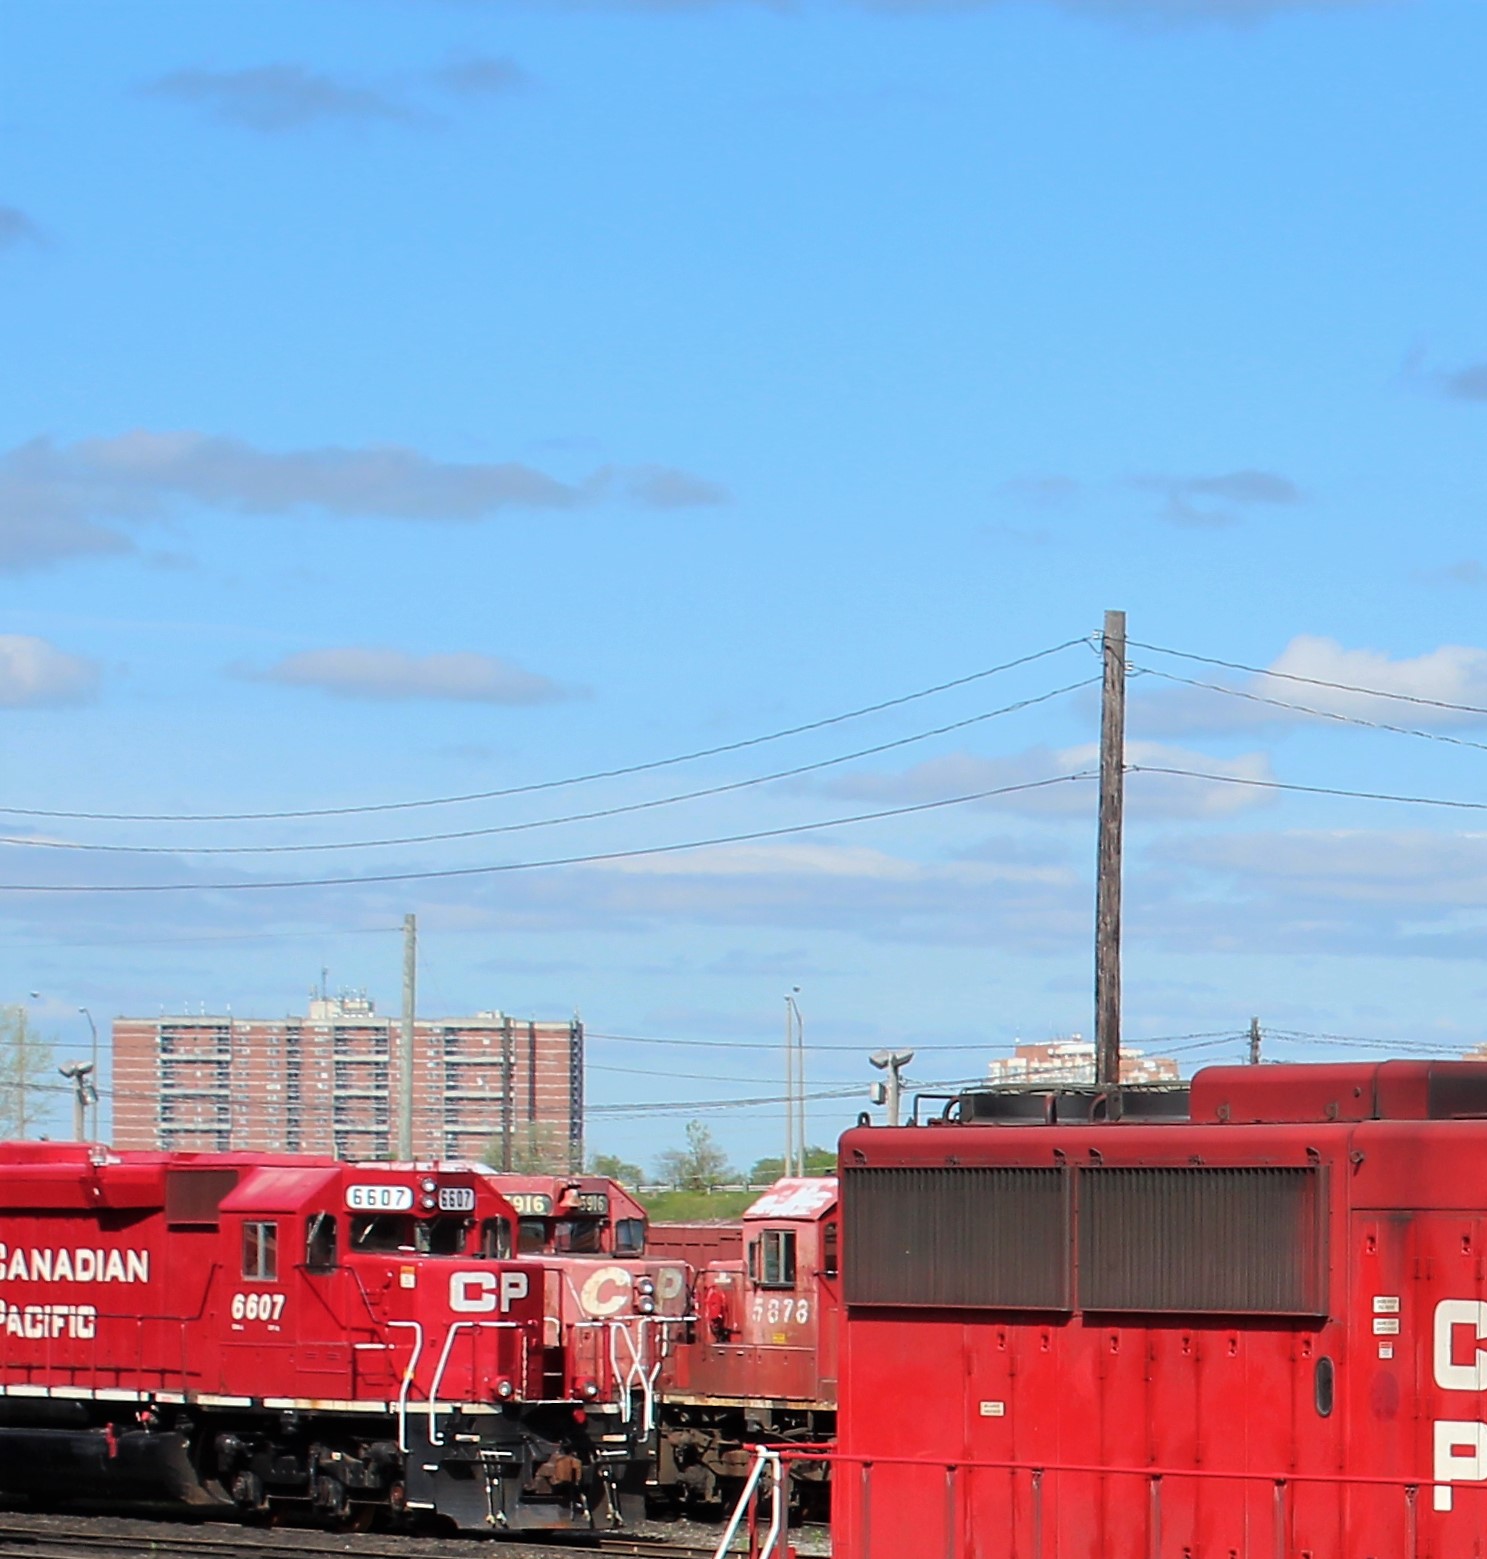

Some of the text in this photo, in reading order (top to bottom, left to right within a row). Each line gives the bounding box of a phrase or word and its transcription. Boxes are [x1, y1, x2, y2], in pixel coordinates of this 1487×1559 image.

[353, 1188, 405, 1206] 6607
[441, 1188, 471, 1208] 6607
[502, 1195, 544, 1212] 916
[450, 1271, 528, 1312] CP
[0, 1299, 95, 1338] ACIFIC
[231, 1293, 286, 1321] 6607
